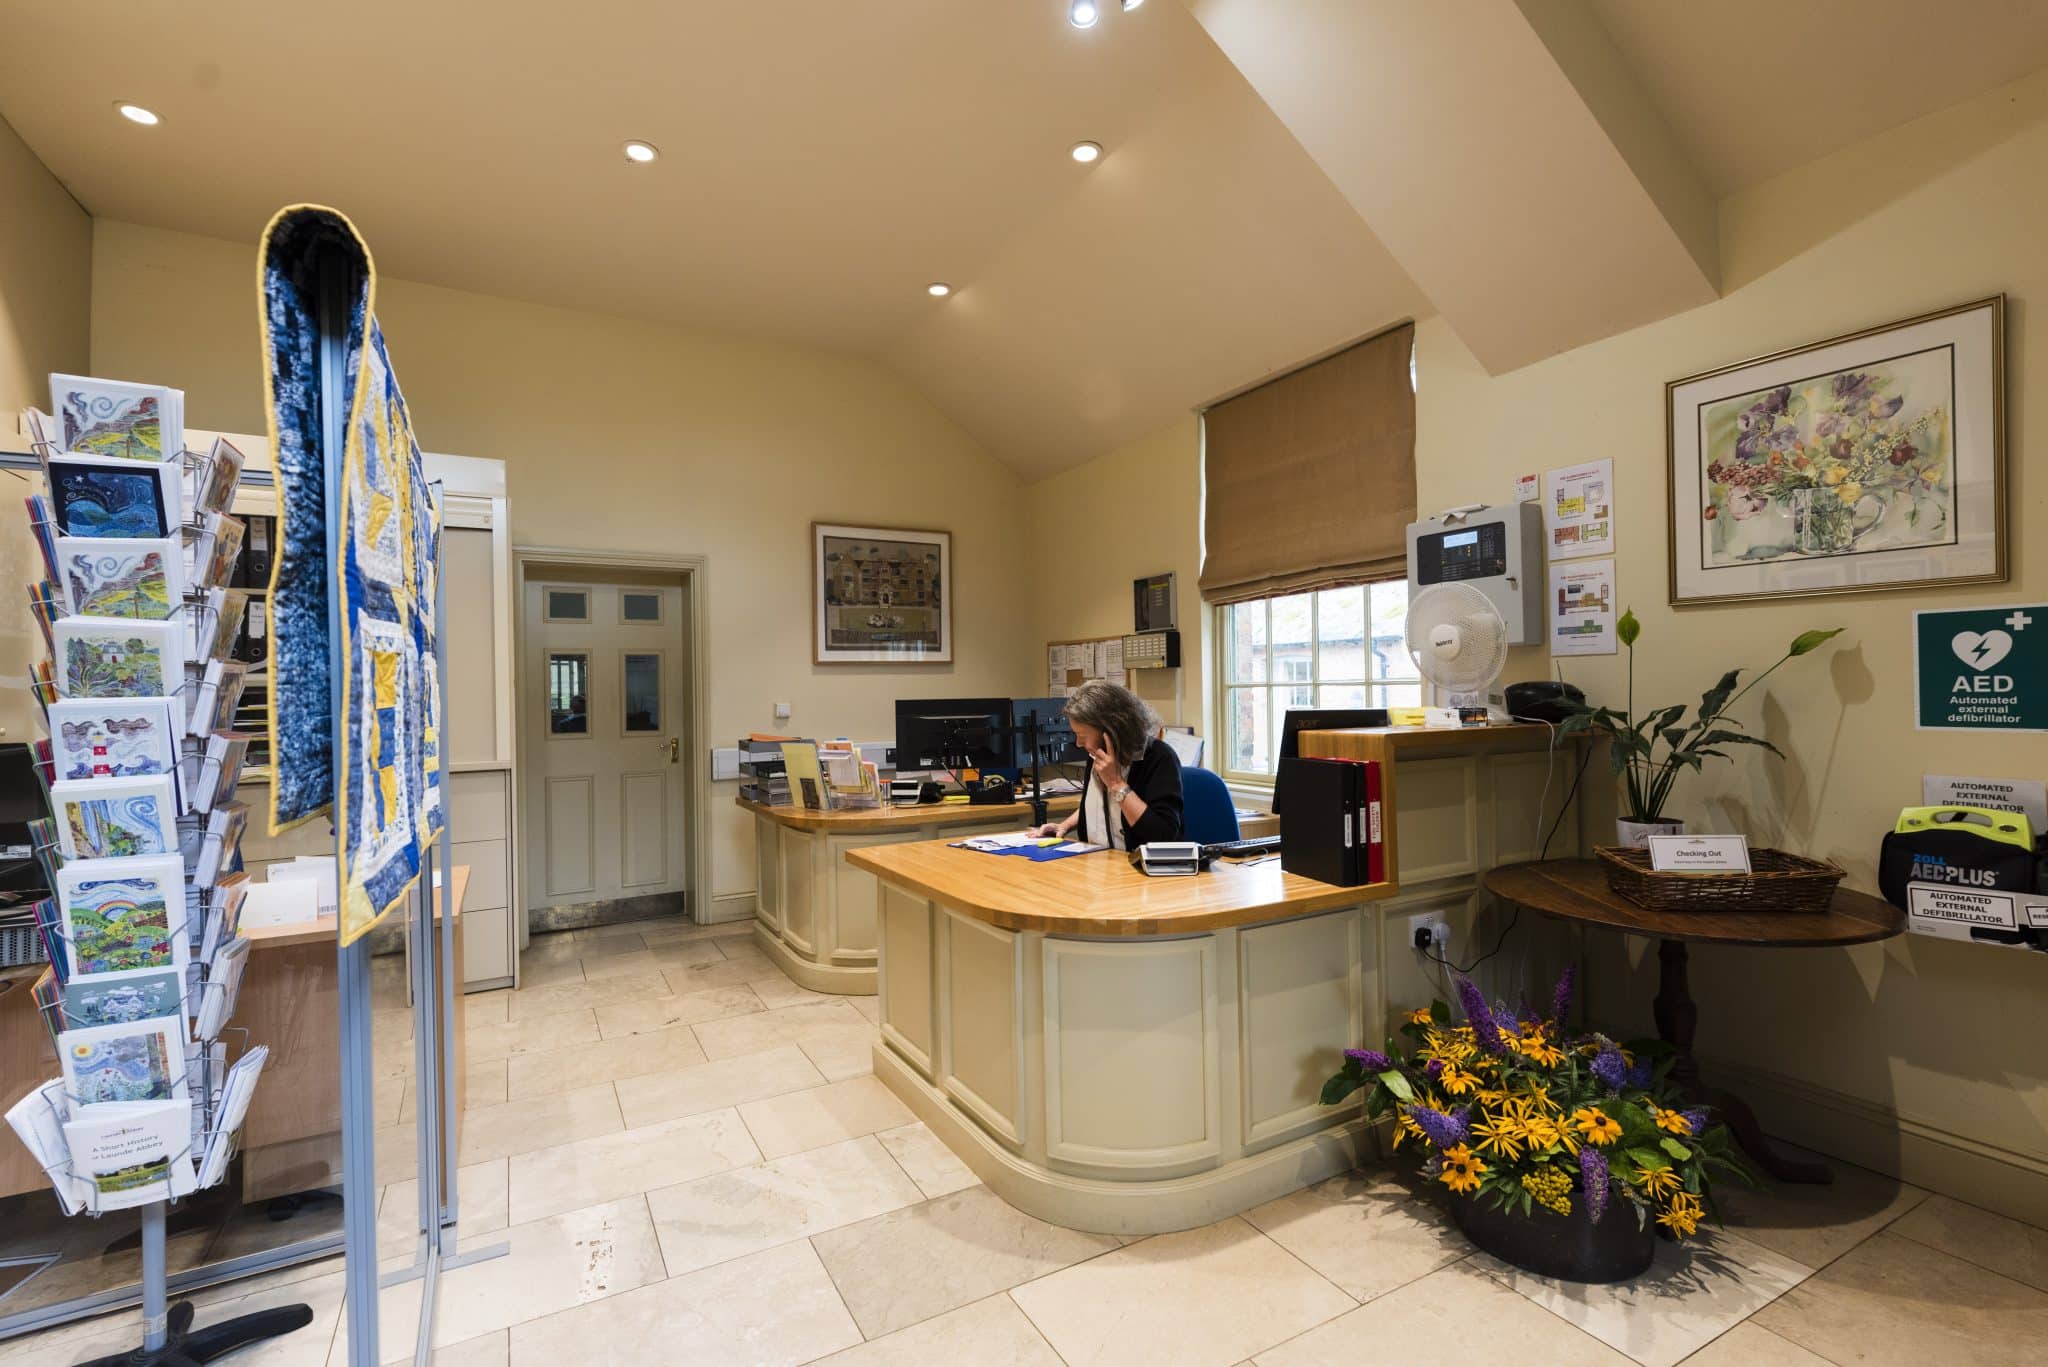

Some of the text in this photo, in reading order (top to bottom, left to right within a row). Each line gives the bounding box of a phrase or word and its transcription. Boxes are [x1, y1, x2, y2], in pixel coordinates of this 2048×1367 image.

[1951, 675, 2014, 693] AED
[1949, 695, 2018, 705] Automated
[1958, 705, 2009, 714] external
[1947, 714, 2022, 723] defibrillator
[1950, 782, 2014, 793] AUTOMATED
[1956, 791, 2009, 802] EXTERNAL
[1676, 850, 1708, 858] Checking
[1913, 854, 1947, 865] ZOLL
[1930, 892, 1992, 905] AUTOMATED
[1935, 901, 1988, 913] EXTERNAL
[1922, 908, 2004, 924] DEFIBRILLATOR
